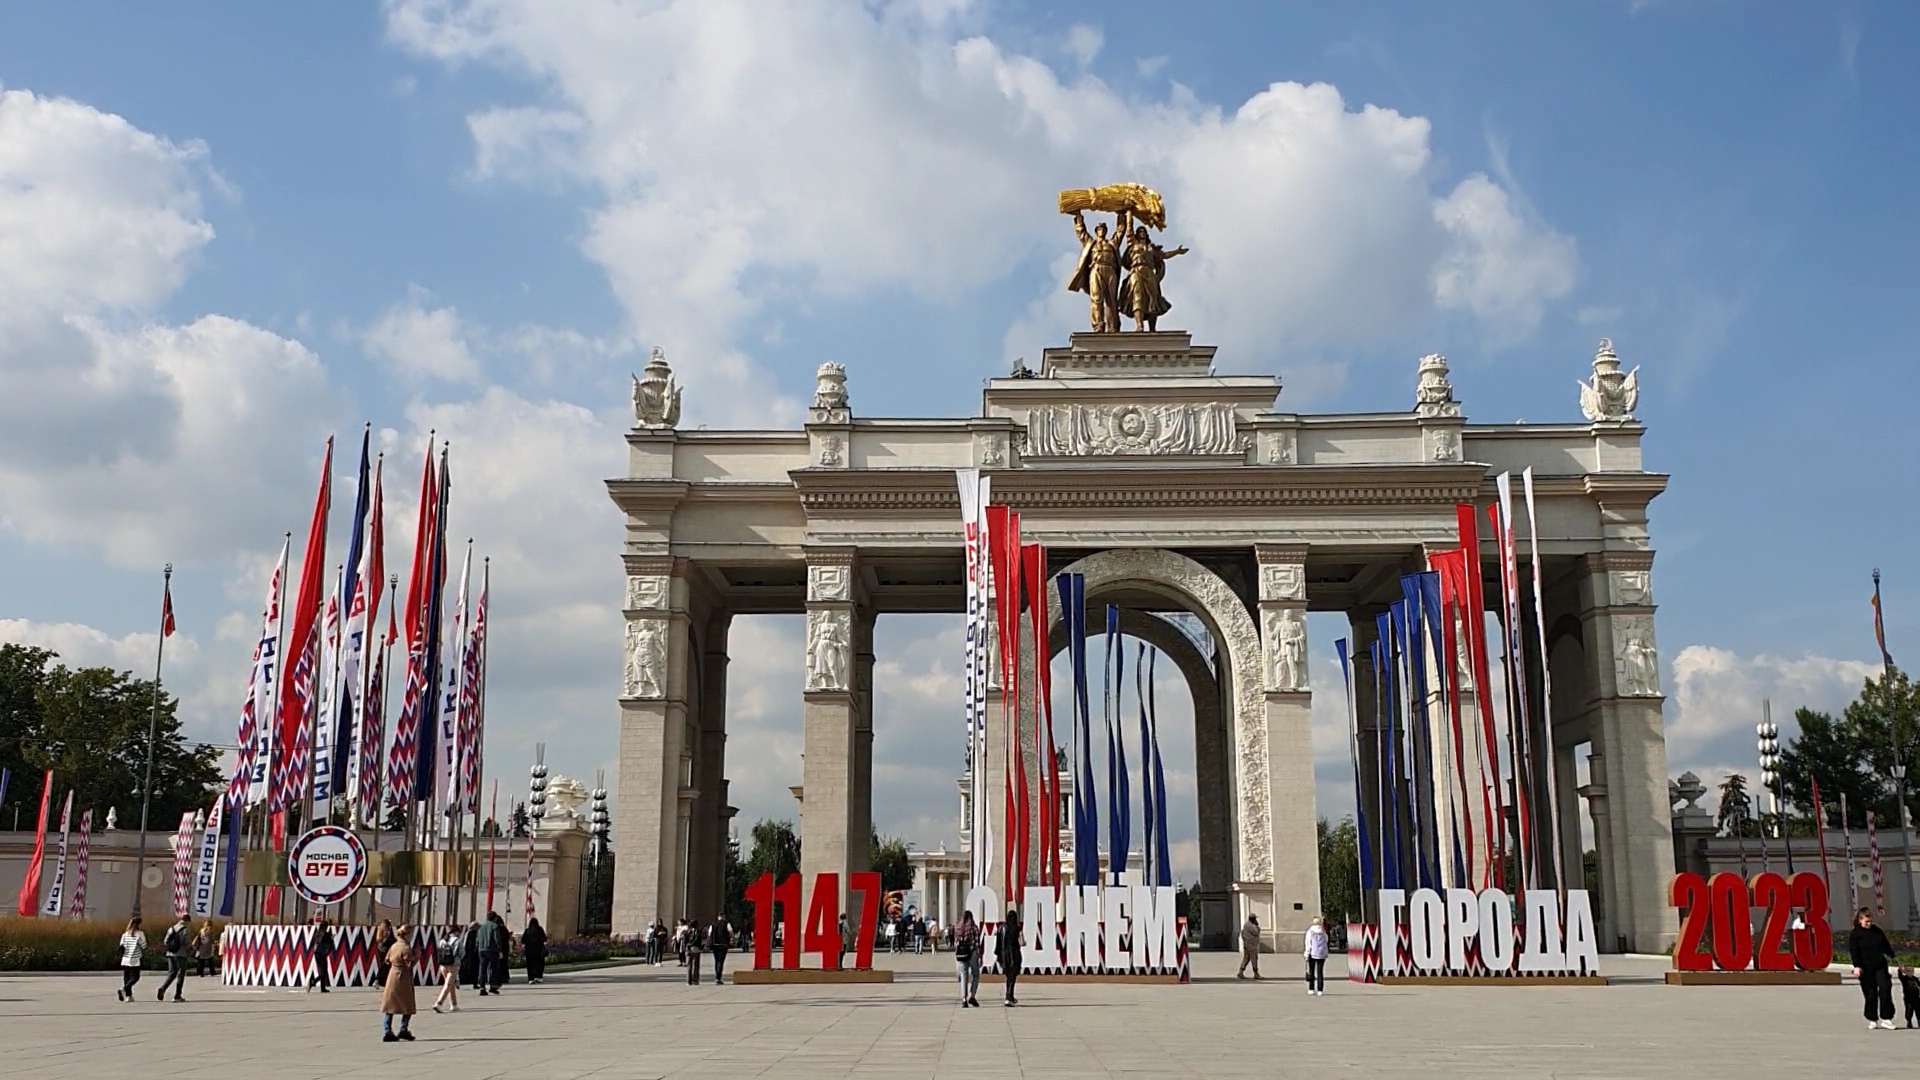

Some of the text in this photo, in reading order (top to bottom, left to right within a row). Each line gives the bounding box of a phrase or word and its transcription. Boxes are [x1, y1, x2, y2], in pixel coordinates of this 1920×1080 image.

[196, 834, 216, 913] МОСКВА
[305, 862, 348, 876] 876
[743, 871, 882, 970] 1147
[1378, 888, 1600, 971] ГОРОДА
[1671, 871, 1833, 970] 2023
